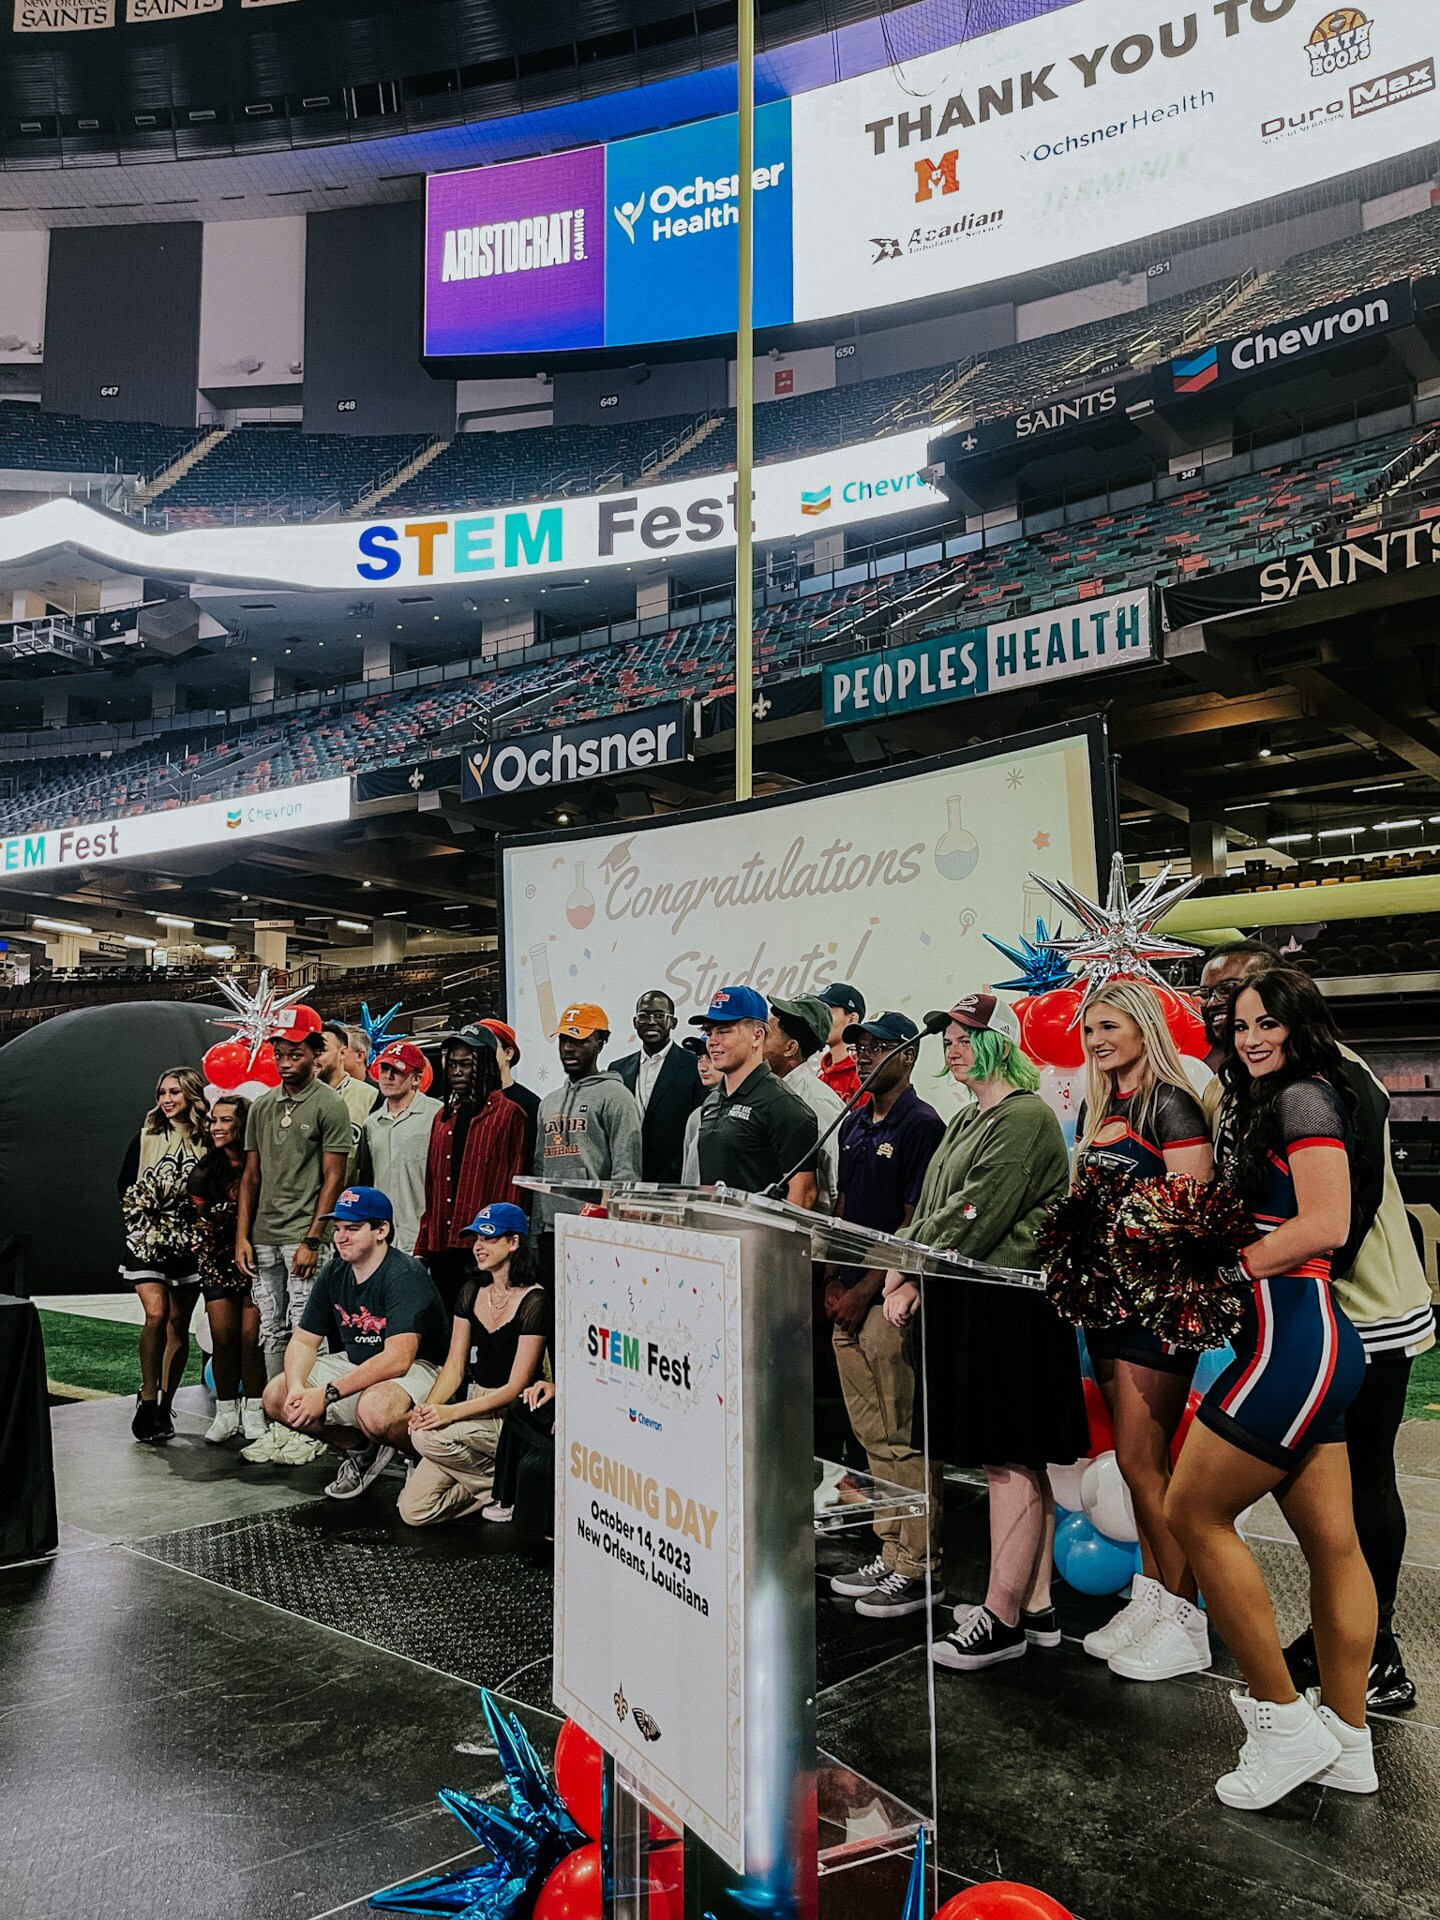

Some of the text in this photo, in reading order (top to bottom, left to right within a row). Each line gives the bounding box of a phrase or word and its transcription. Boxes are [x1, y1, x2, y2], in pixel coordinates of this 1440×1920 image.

[22, 6, 107, 27] SAINTS
[865, 0, 1298, 156] THANK YOU TO
[1352, 65, 1432, 107] Max
[652, 202, 739, 242] Health
[907, 209, 1004, 248] Acadian
[442, 211, 574, 283] ARISTOCRAT
[1147, 261, 1171, 278] 651
[836, 345, 855, 358] 650
[1231, 298, 1390, 371] Chevron
[101, 387, 119, 396] 647
[338, 401, 356, 411] 648
[600, 396, 618, 408] 649
[1015, 386, 1117, 439] SAINTS
[843, 473, 927, 503] Chevr
[1181, 468, 1197, 480] 347
[356, 507, 563, 581] STEM
[832, 604, 1140, 714] PEOPLES HEALTH
[492, 720, 677, 793] Ochsner
[247, 801, 303, 823] Chevron
[0, 825, 119, 870] EM Fest
[605, 836, 926, 935] Congratulations
[587, 1324, 691, 1390] STEM Fest
[571, 1441, 719, 1550] SIGNING DAY
[591, 1500, 691, 1575] October 14, 2023
[577, 1517, 709, 1617] New Orleans, Louisiana
